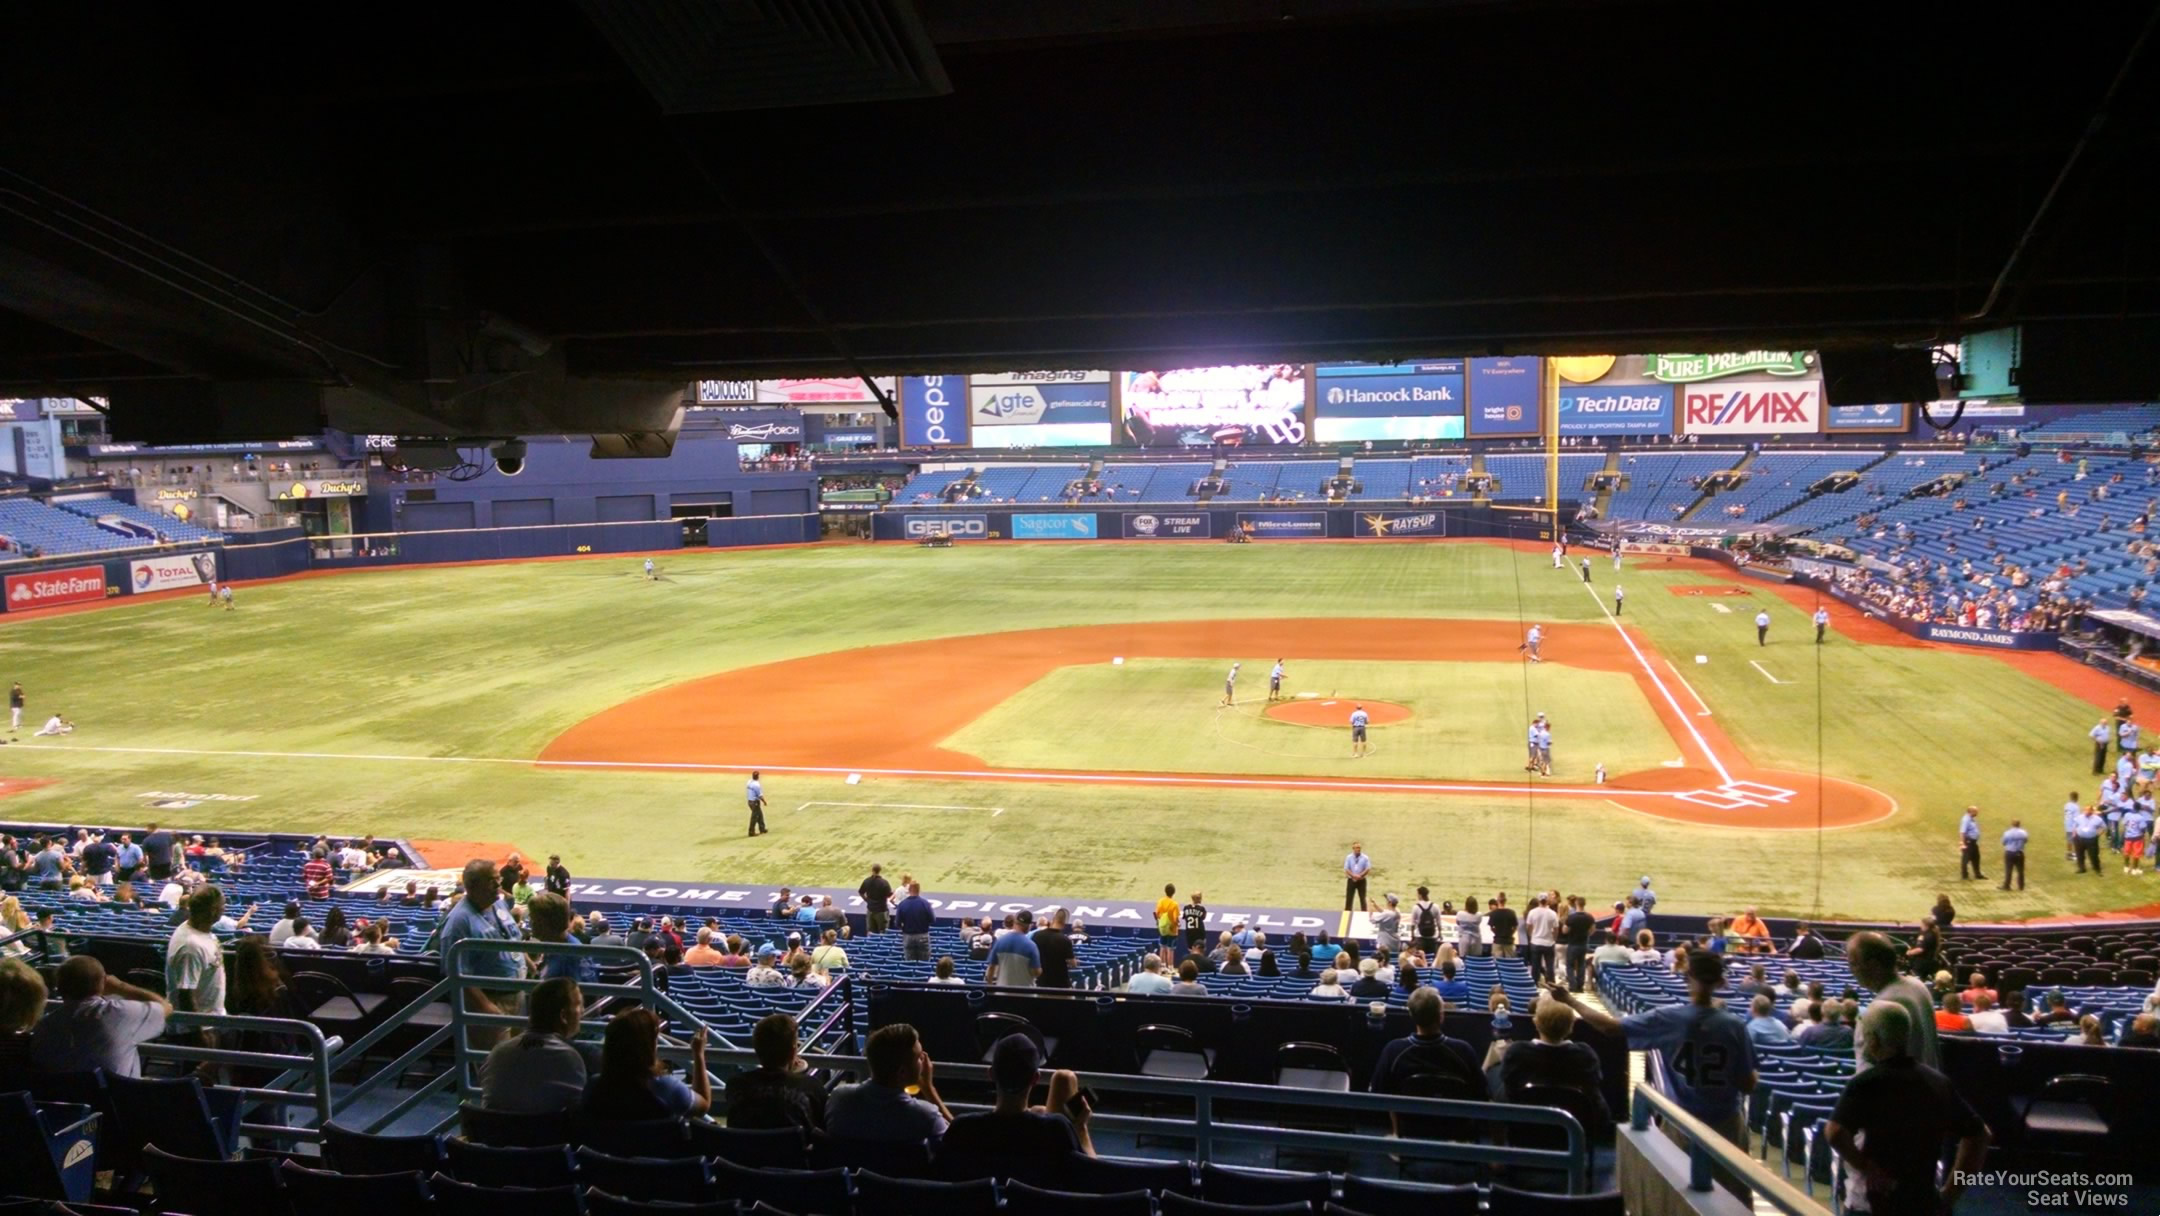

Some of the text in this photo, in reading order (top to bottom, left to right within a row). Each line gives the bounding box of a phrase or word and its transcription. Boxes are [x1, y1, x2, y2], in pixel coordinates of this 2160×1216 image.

[1657, 351, 1792, 377] PURE PREMIUM
[1011, 371, 1086, 381] imaging
[702, 382, 753, 400] RADIOLOGY
[1345, 387, 1452, 403] Hancock Bank
[924, 376, 950, 443] peps
[1001, 393, 1035, 412] gte
[1576, 395, 1661, 413] Tech Data
[1687, 391, 1809, 426] RE/MAX
[769, 426, 799, 435] PORCH
[157, 488, 198, 501] Ducky's
[320, 480, 362, 495] Ducky's
[907, 520, 985, 535] GEICO
[1019, 517, 1068, 531] Sagicor
[1392, 516, 1420, 529] RAYS
[157, 567, 193, 577] TOTAL
[33, 577, 101, 598] State Farm
[1930, 628, 2015, 644] RAYMOND JAMES
[848, 895, 1325, 928] TPICANA IELD
[1187, 916, 1199, 929] 21
[1672, 1040, 1729, 1089] 42
